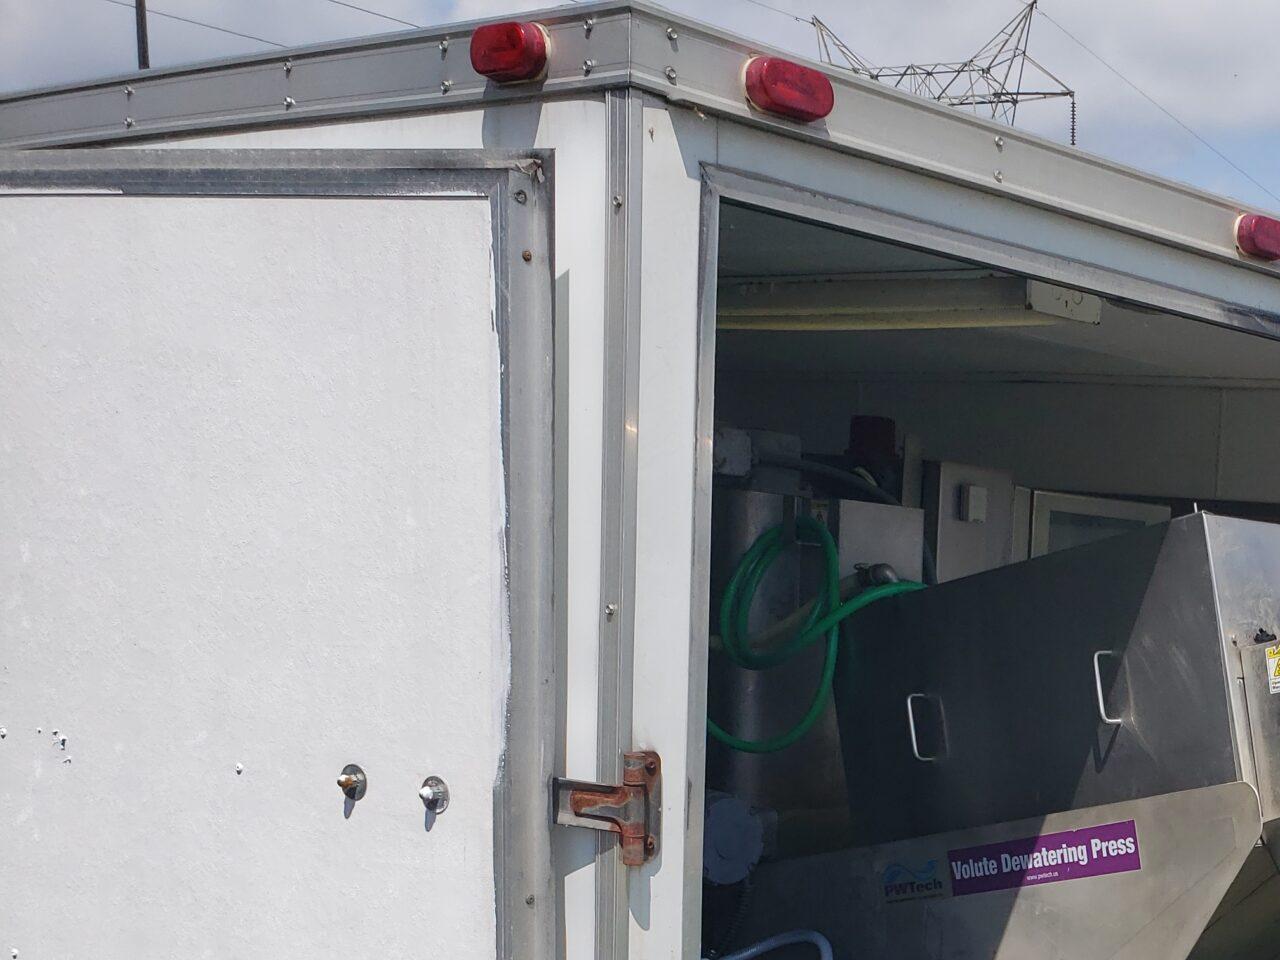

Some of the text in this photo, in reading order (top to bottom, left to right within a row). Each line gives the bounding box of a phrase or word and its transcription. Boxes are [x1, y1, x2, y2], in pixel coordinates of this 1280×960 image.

[952, 836, 1136, 880] Volute Dewatering Press
[884, 877, 943, 897] PWTech
